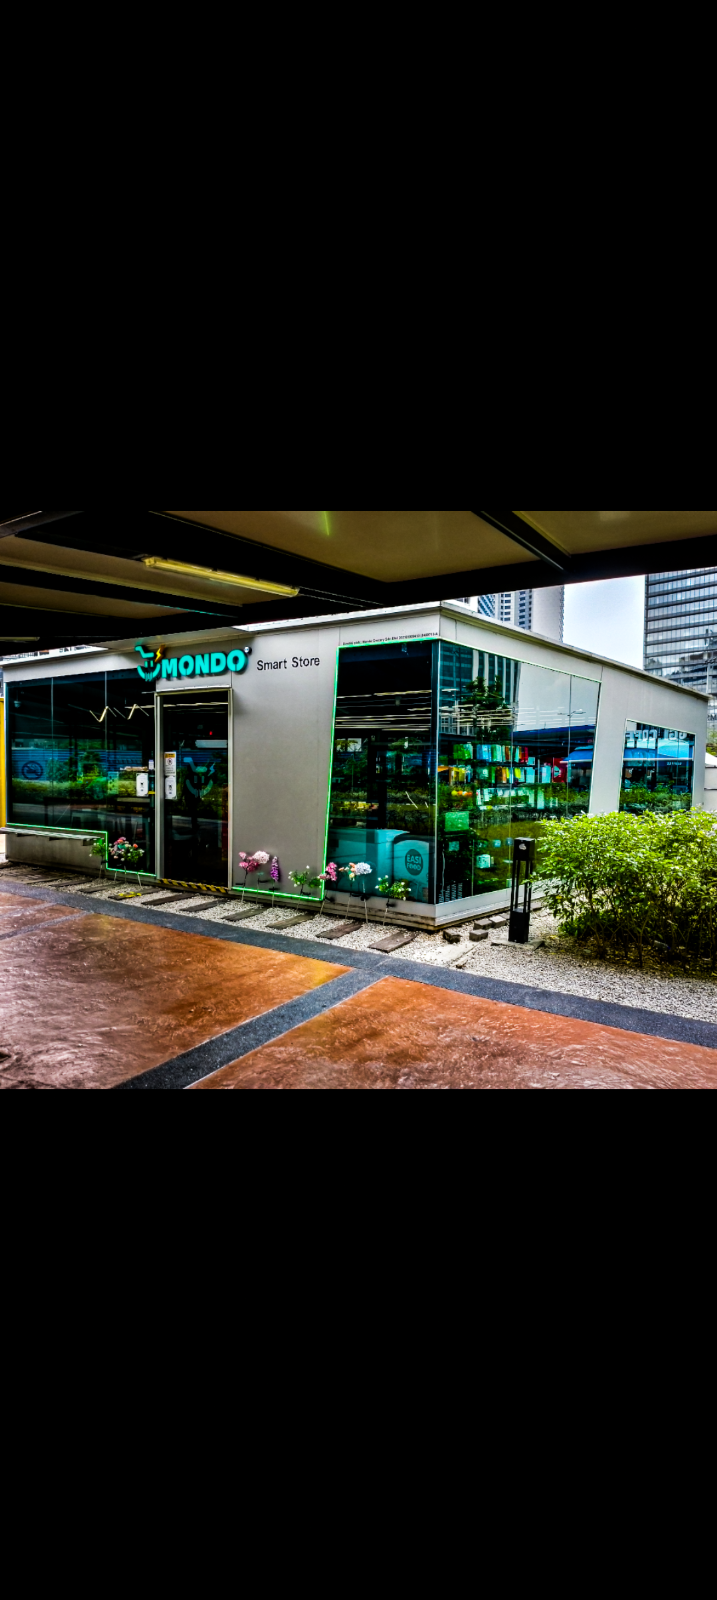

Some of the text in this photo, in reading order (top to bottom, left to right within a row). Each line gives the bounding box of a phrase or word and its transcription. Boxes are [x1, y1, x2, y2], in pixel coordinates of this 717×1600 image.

[162, 648, 247, 679] MONDO
[256, 655, 320, 671] Smart Store
